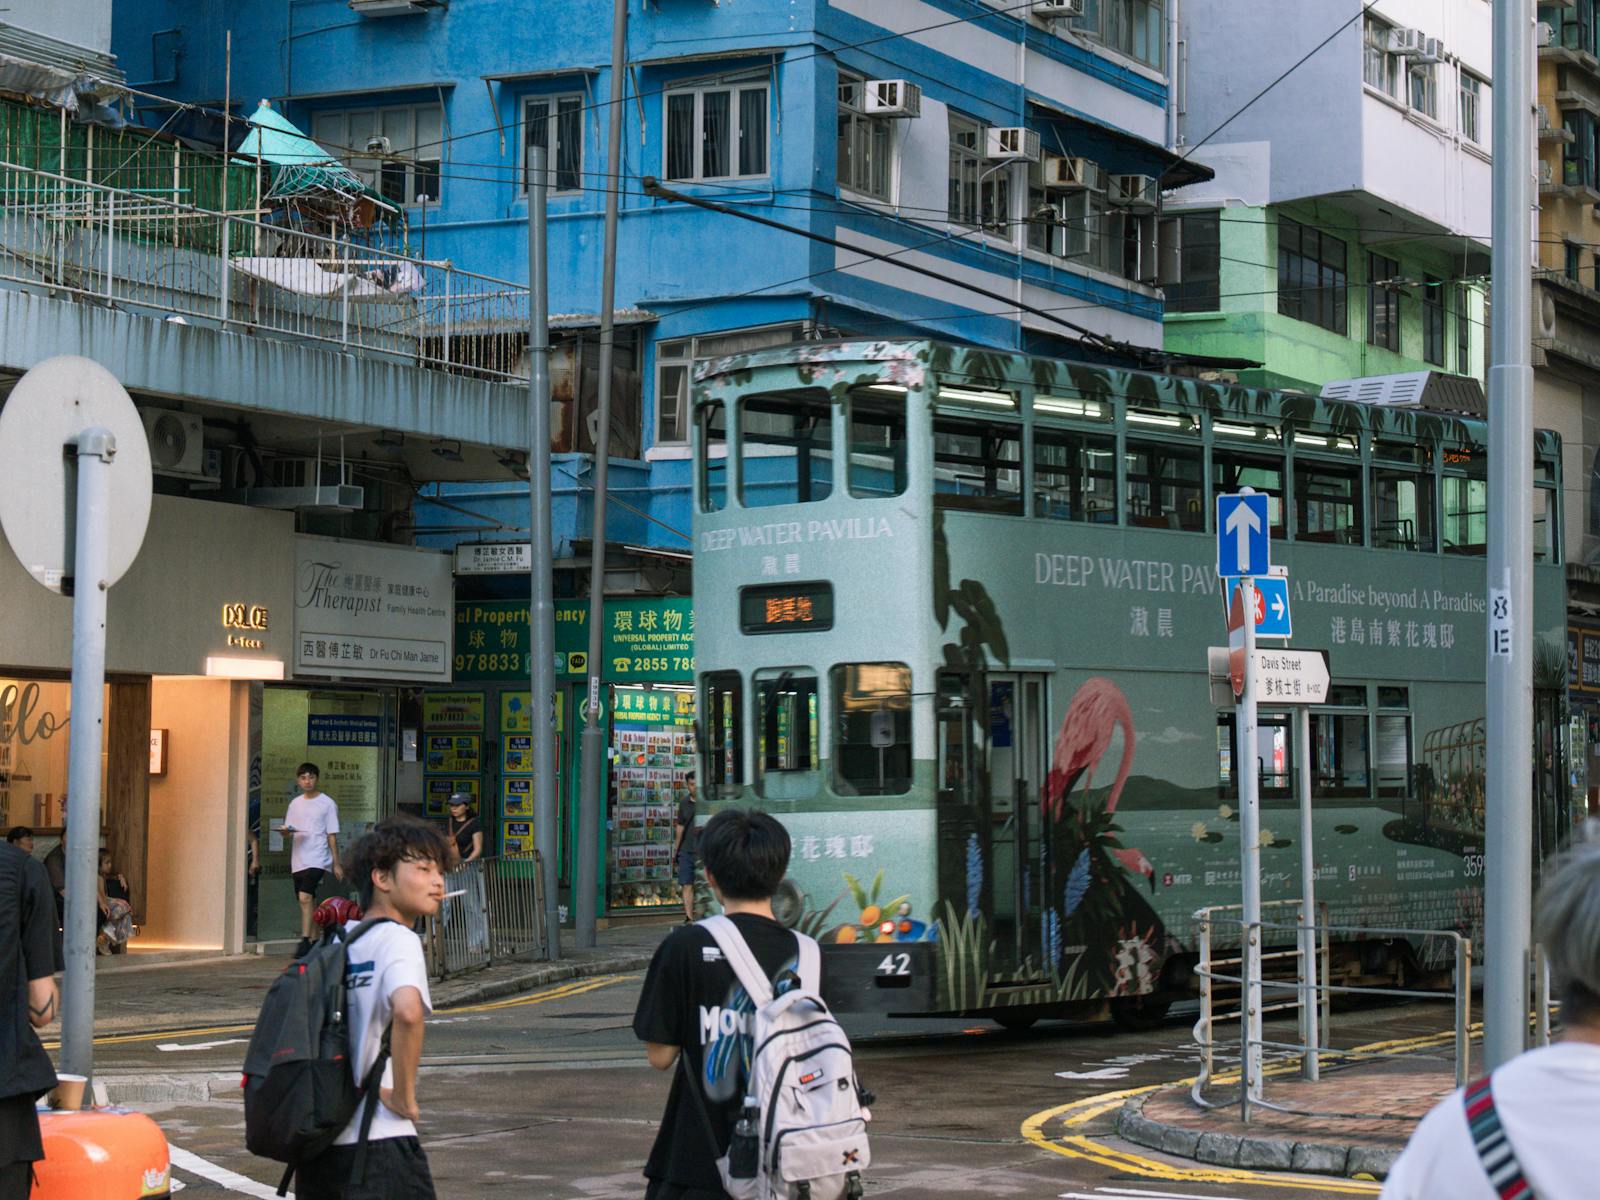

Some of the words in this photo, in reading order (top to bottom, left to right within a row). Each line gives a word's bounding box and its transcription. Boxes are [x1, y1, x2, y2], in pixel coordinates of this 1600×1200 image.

[701, 529, 736, 552] DEEP
[738, 522, 801, 546] WATER
[808, 517, 893, 542] PAVILIA
[1035, 553, 1094, 587] DEEP
[1099, 557, 1175, 592] WATER
[1181, 564, 1218, 595] PAV
[297, 586, 382, 616] Therapist
[1293, 582, 1304, 601] A
[1307, 580, 1365, 606] Paradise
[1368, 585, 1417, 613] beyond
[1420, 591, 1431, 610] A
[1433, 589, 1486, 614] Paradise
[387, 603, 406, 616] Family
[407, 605, 426, 615] Health
[556, 610, 586, 625] ency
[613, 634, 646, 642] UNIVERSAL
[647, 634, 680, 642] PROPERTY
[631, 643, 662, 651] (GLOBAL)
[663, 643, 689, 651] LIMITED
[303, 640, 364, 661] 西醫傅芷敏
[370, 648, 378, 659] Dr
[380, 649, 389, 660] Fu
[391, 649, 402, 661] Chi
[403, 650, 418, 662] Man
[419, 651, 439, 663] Jamie
[634, 657, 668, 671] 2855
[1261, 656, 1279, 670] Davis
[1282, 657, 1302, 671] Street
[792, 834, 874, 861] 花瑰邸
[1463, 855, 1485, 878] 359
[1174, 874, 1193, 884] MTR
[877, 952, 911, 975] 42
